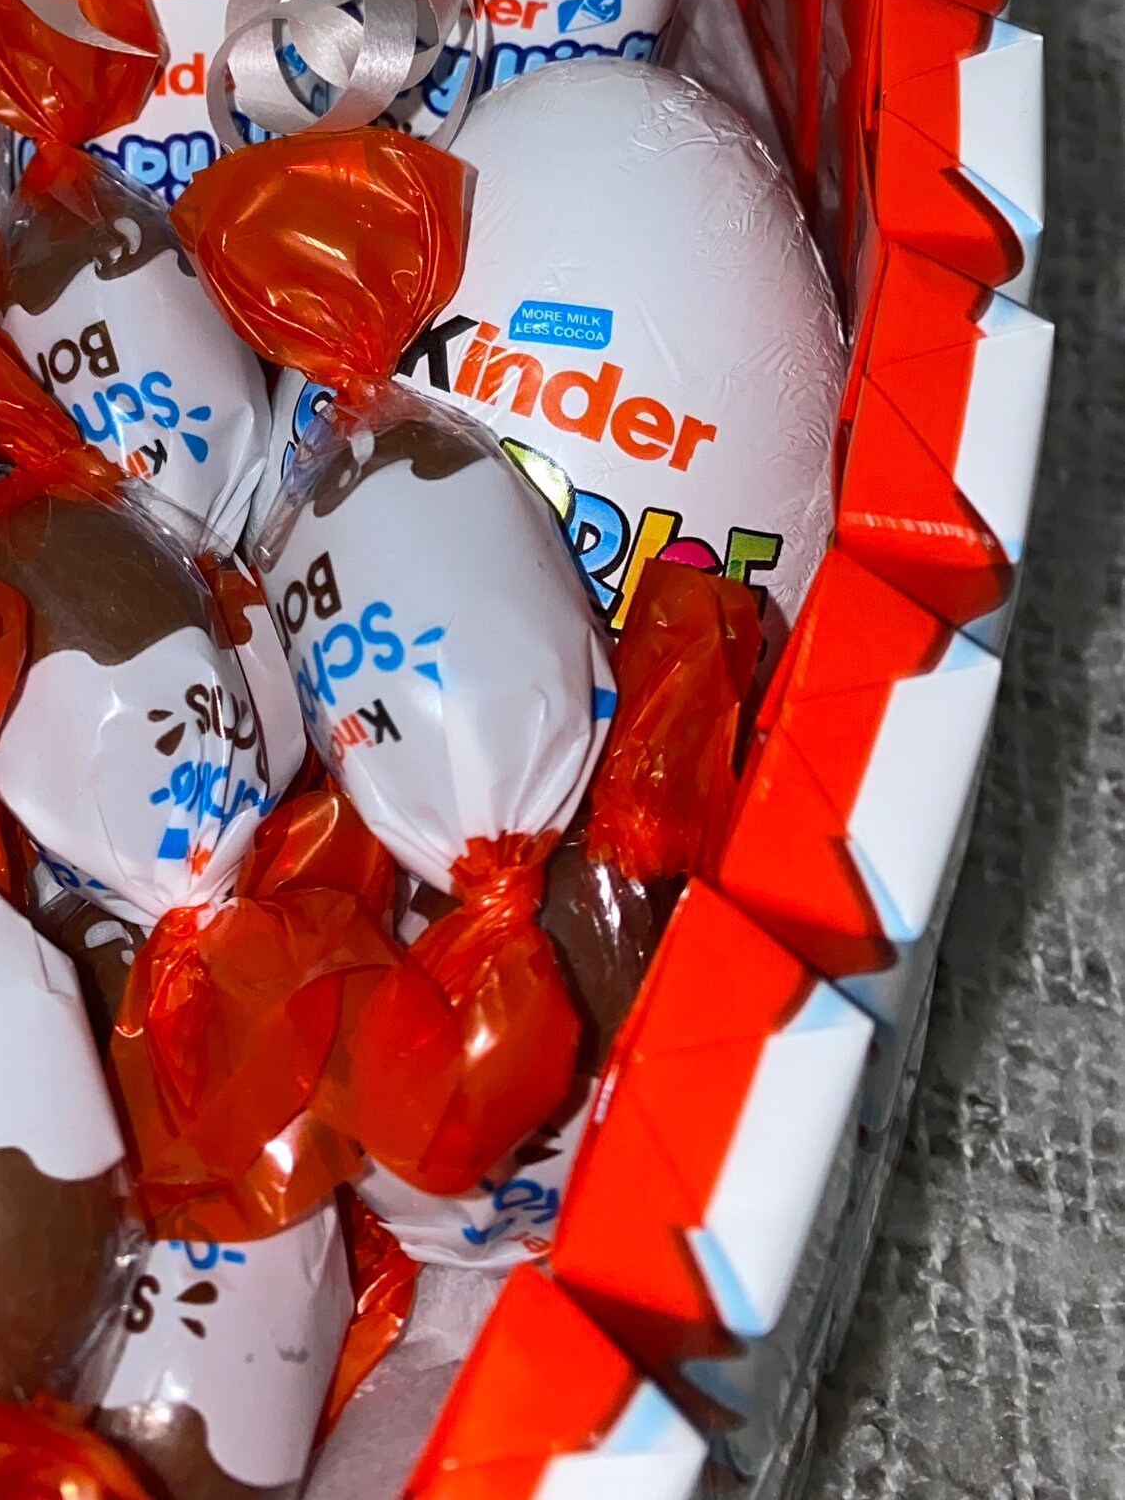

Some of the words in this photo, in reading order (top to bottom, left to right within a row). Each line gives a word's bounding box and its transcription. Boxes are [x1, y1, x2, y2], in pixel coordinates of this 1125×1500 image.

[521, 308, 563, 322] MORE
[567, 313, 602, 327] MILK
[513, 322, 550, 335] LESS
[554, 326, 605, 342] COCOA
[395, 314, 718, 472] Kinder
